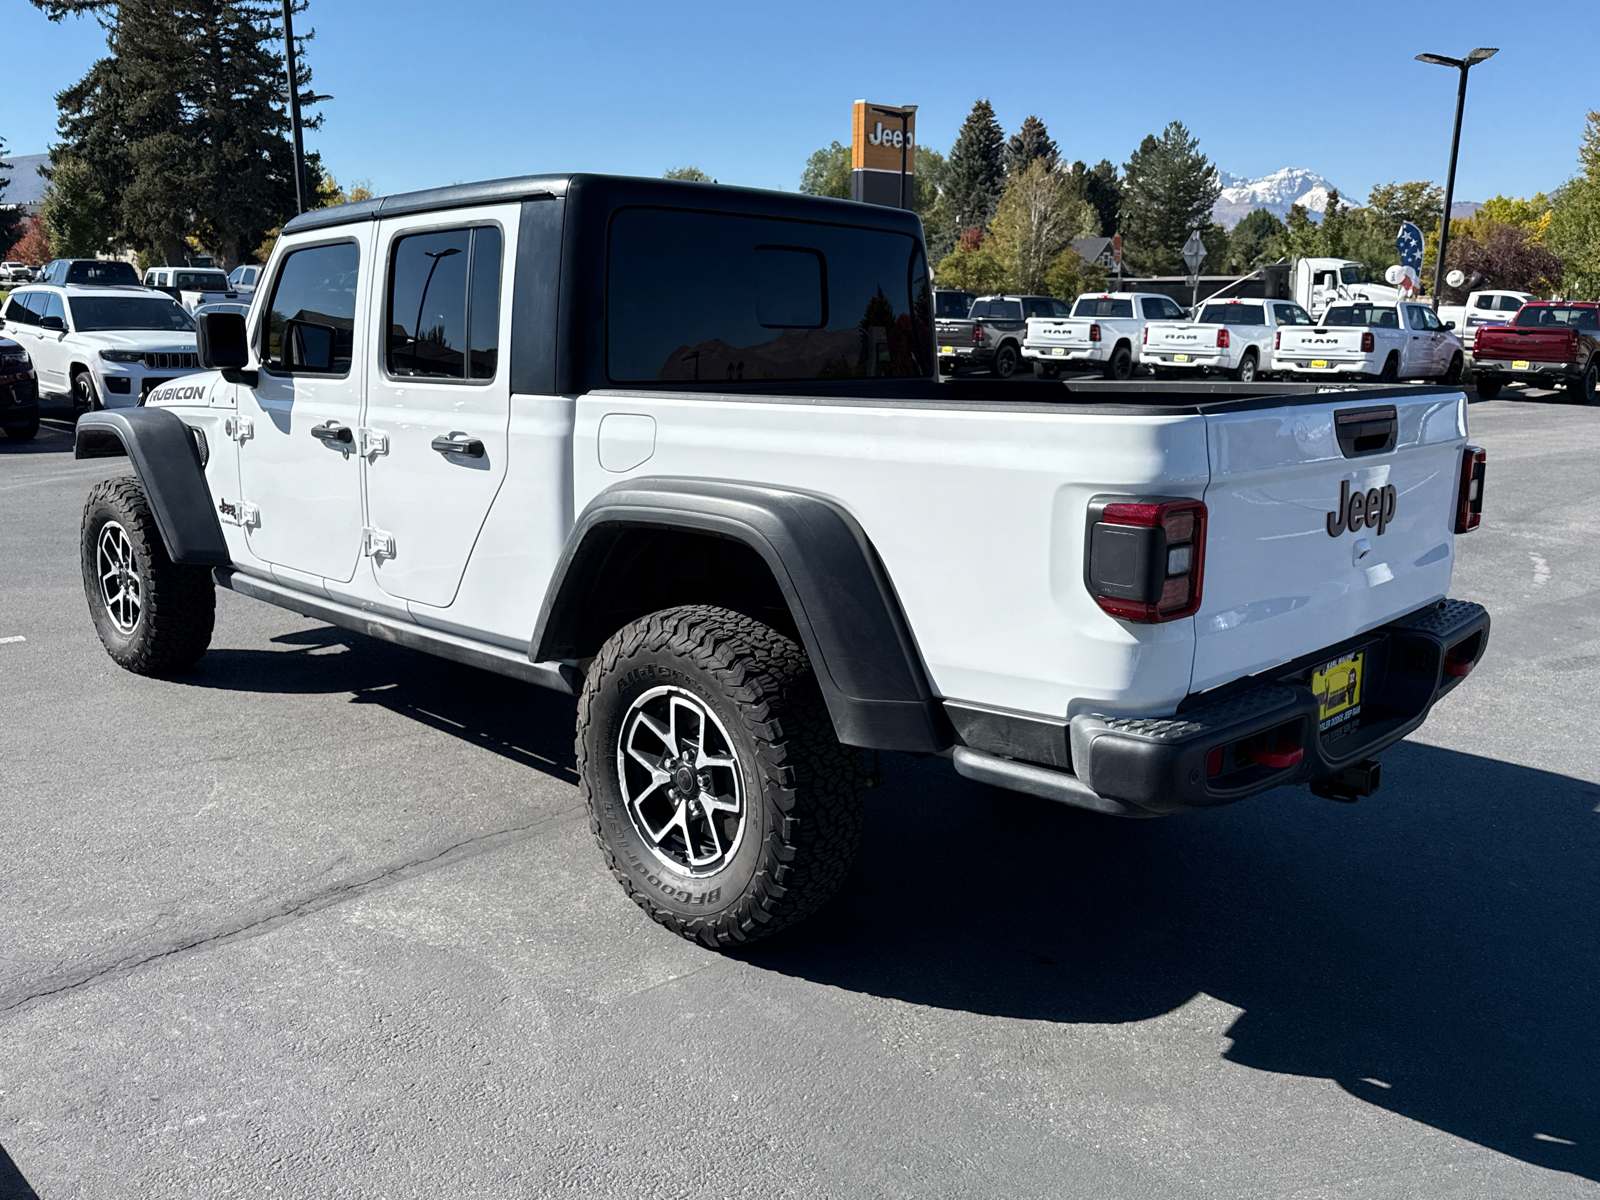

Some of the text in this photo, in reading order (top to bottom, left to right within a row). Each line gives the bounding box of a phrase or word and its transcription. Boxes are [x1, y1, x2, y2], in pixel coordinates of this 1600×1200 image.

[149, 386, 207, 402] RUBICON
[1326, 479, 1397, 538] Jeep
[1343, 709, 1353, 720] JEEP
[603, 801, 721, 906] BFGoodrich
